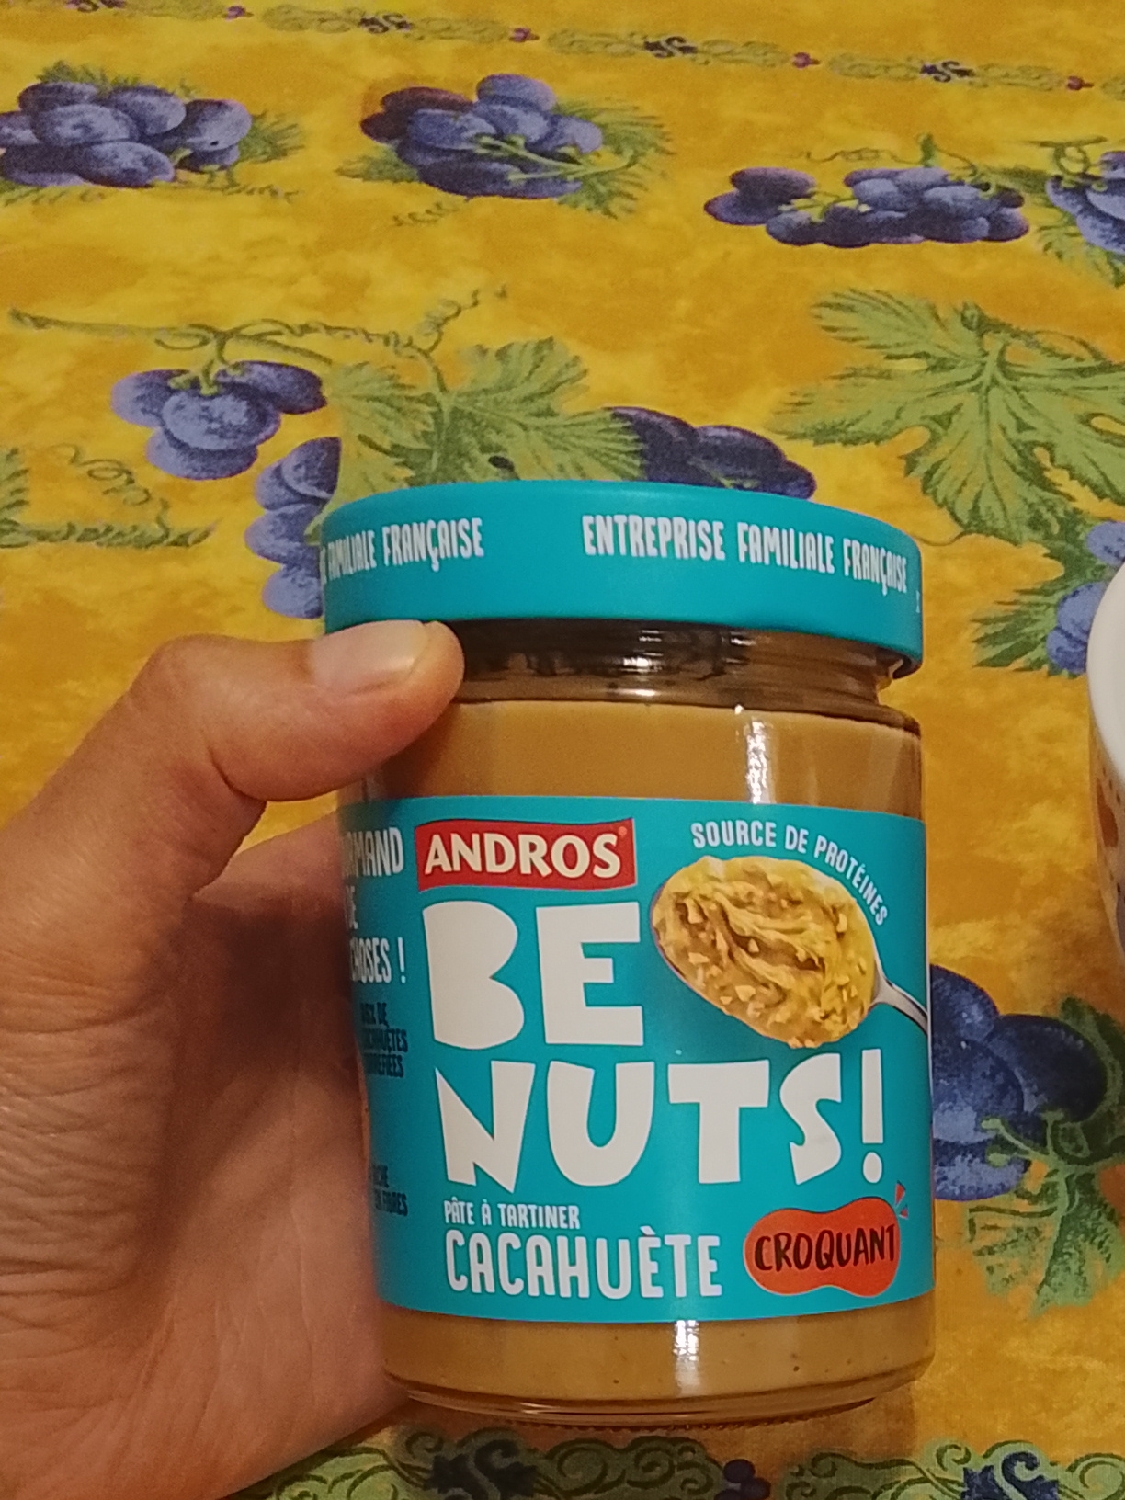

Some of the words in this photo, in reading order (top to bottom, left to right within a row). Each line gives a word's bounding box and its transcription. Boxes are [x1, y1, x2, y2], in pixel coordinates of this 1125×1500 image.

[381, 517, 484, 573] FRANÇAISE
[582, 514, 726, 561] ENTREPRISE
[737, 521, 835, 575] FAMILIALE
[843, 538, 907, 597] FRANÇAISE
[425, 832, 621, 879] ANDROS
[690, 819, 777, 849] SOURCE
[785, 824, 809, 855] DE
[814, 834, 889, 926] PROTÉINES
[422, 900, 644, 1051] BE
[435, 1048, 884, 1194] NUTS!
[443, 1197, 475, 1225] PÂTE
[481, 1199, 492, 1226] À
[497, 1203, 581, 1230] TARTINER
[755, 1223, 895, 1272] CROQUANT
[445, 1225, 723, 1300] CACAHUÈTE
